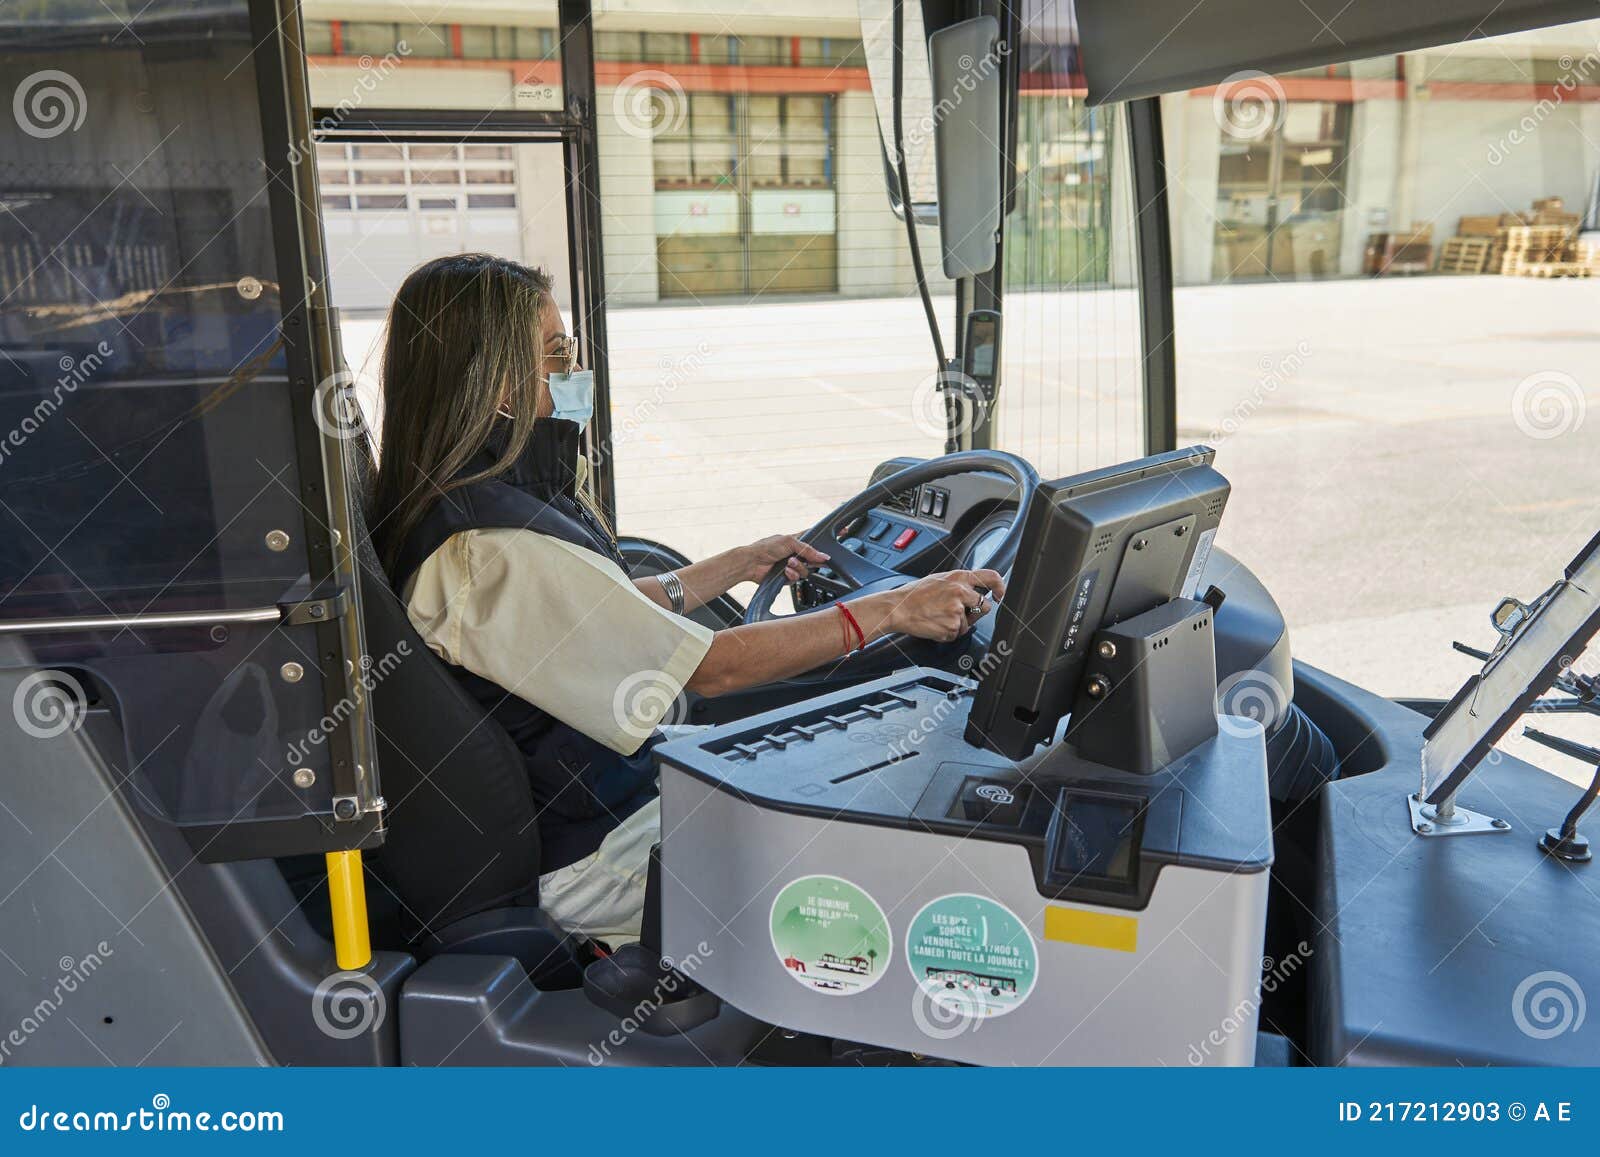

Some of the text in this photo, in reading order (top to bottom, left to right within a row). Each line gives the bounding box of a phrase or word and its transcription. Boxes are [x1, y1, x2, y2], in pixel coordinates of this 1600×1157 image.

[932, 913, 948, 925] LES
[914, 945, 945, 958] SAMEDI
[946, 949, 972, 962] TOUTE
[974, 951, 985, 964] LA
